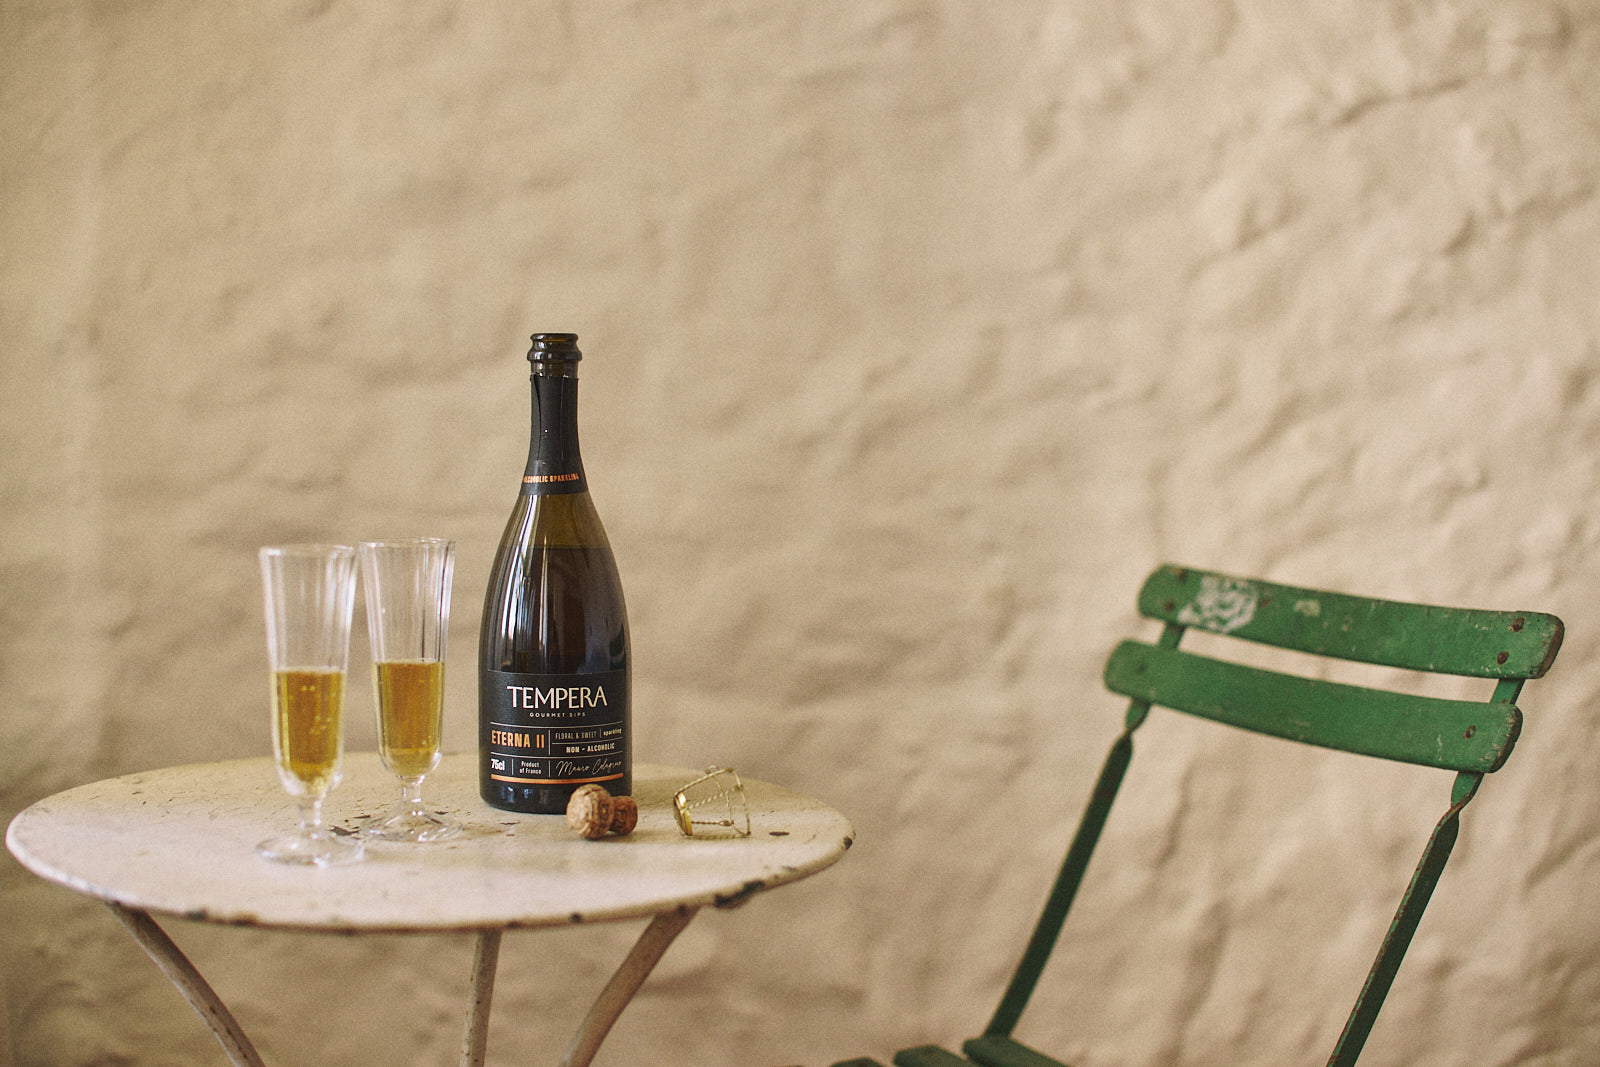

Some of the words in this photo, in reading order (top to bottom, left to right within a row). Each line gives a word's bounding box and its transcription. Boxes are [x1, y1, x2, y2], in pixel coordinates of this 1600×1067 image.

[506, 686, 608, 709] TEMPERA
[555, 732, 574, 740] FLORAL
[581, 731, 597, 739] SWEET
[603, 728, 622, 736] sparkling
[491, 730, 531, 748] ETERNA
[536, 734, 544, 748] II
[587, 742, 615, 752] ALCOHOLIC
[490, 758, 506, 771] 75cl
